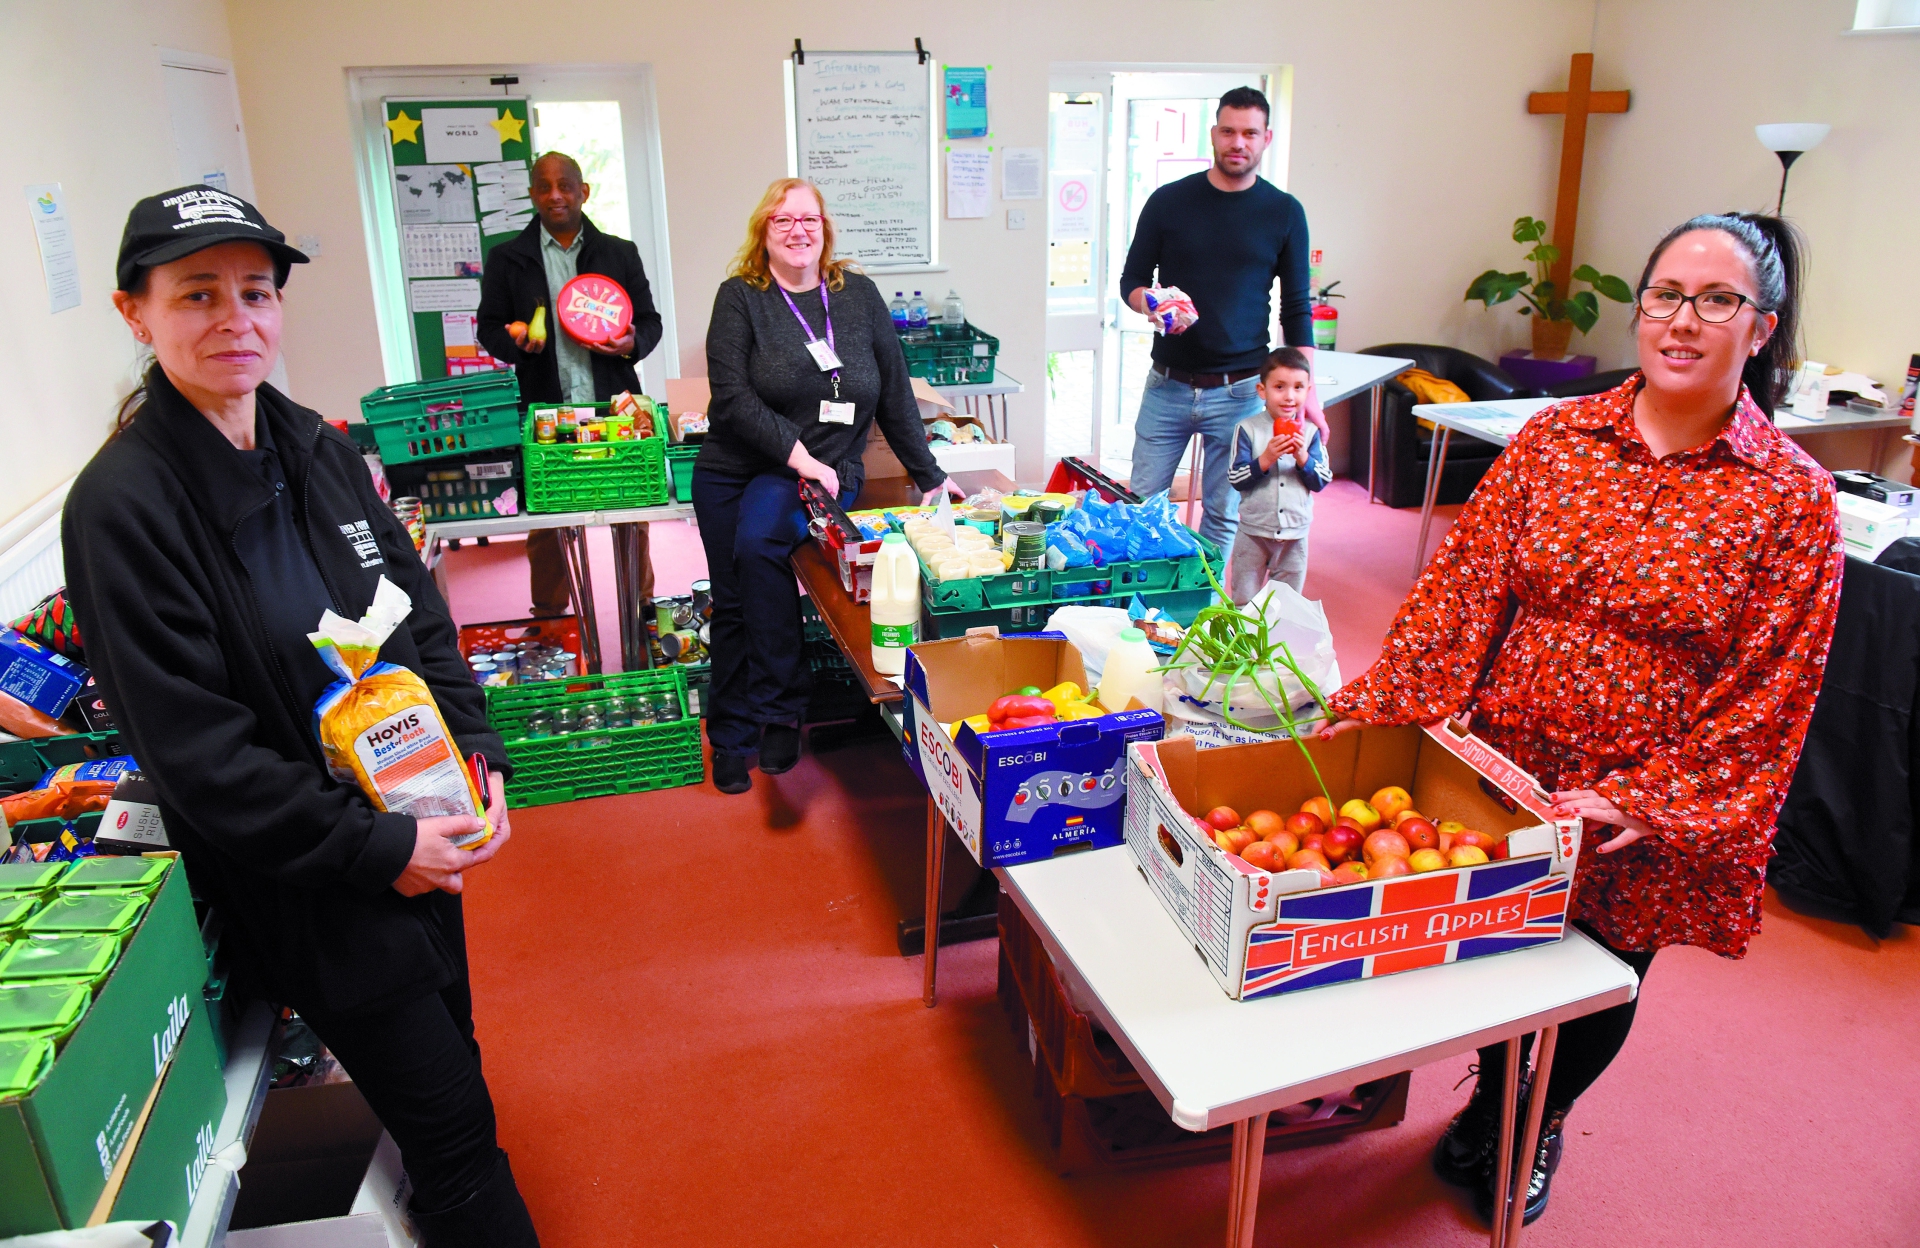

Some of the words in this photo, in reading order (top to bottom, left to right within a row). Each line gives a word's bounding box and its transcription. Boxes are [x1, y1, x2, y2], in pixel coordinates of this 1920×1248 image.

[814, 60, 880, 75] Information
[162, 190, 199, 208] DRIVEN
[366, 714, 420, 748] HOVIS
[374, 742, 396, 758] Best
[395, 737, 402, 746] of
[402, 727, 426, 742] Both
[1212, 728, 1220, 738] it
[1235, 734, 1247, 744] as
[1460, 740, 1495, 770] SIMPLY
[1500, 770, 1530, 795] BEST
[134, 807, 152, 839] SUSHI
[146, 812, 160, 837] RICE
[1202, 854, 1213, 871] SIZE
[1213, 868, 1224, 881] mm
[1300, 922, 1409, 961] ENGLISH
[1424, 902, 1523, 939] APPLES
[153, 992, 191, 1078] Laila
[186, 1120, 214, 1207] Laila
